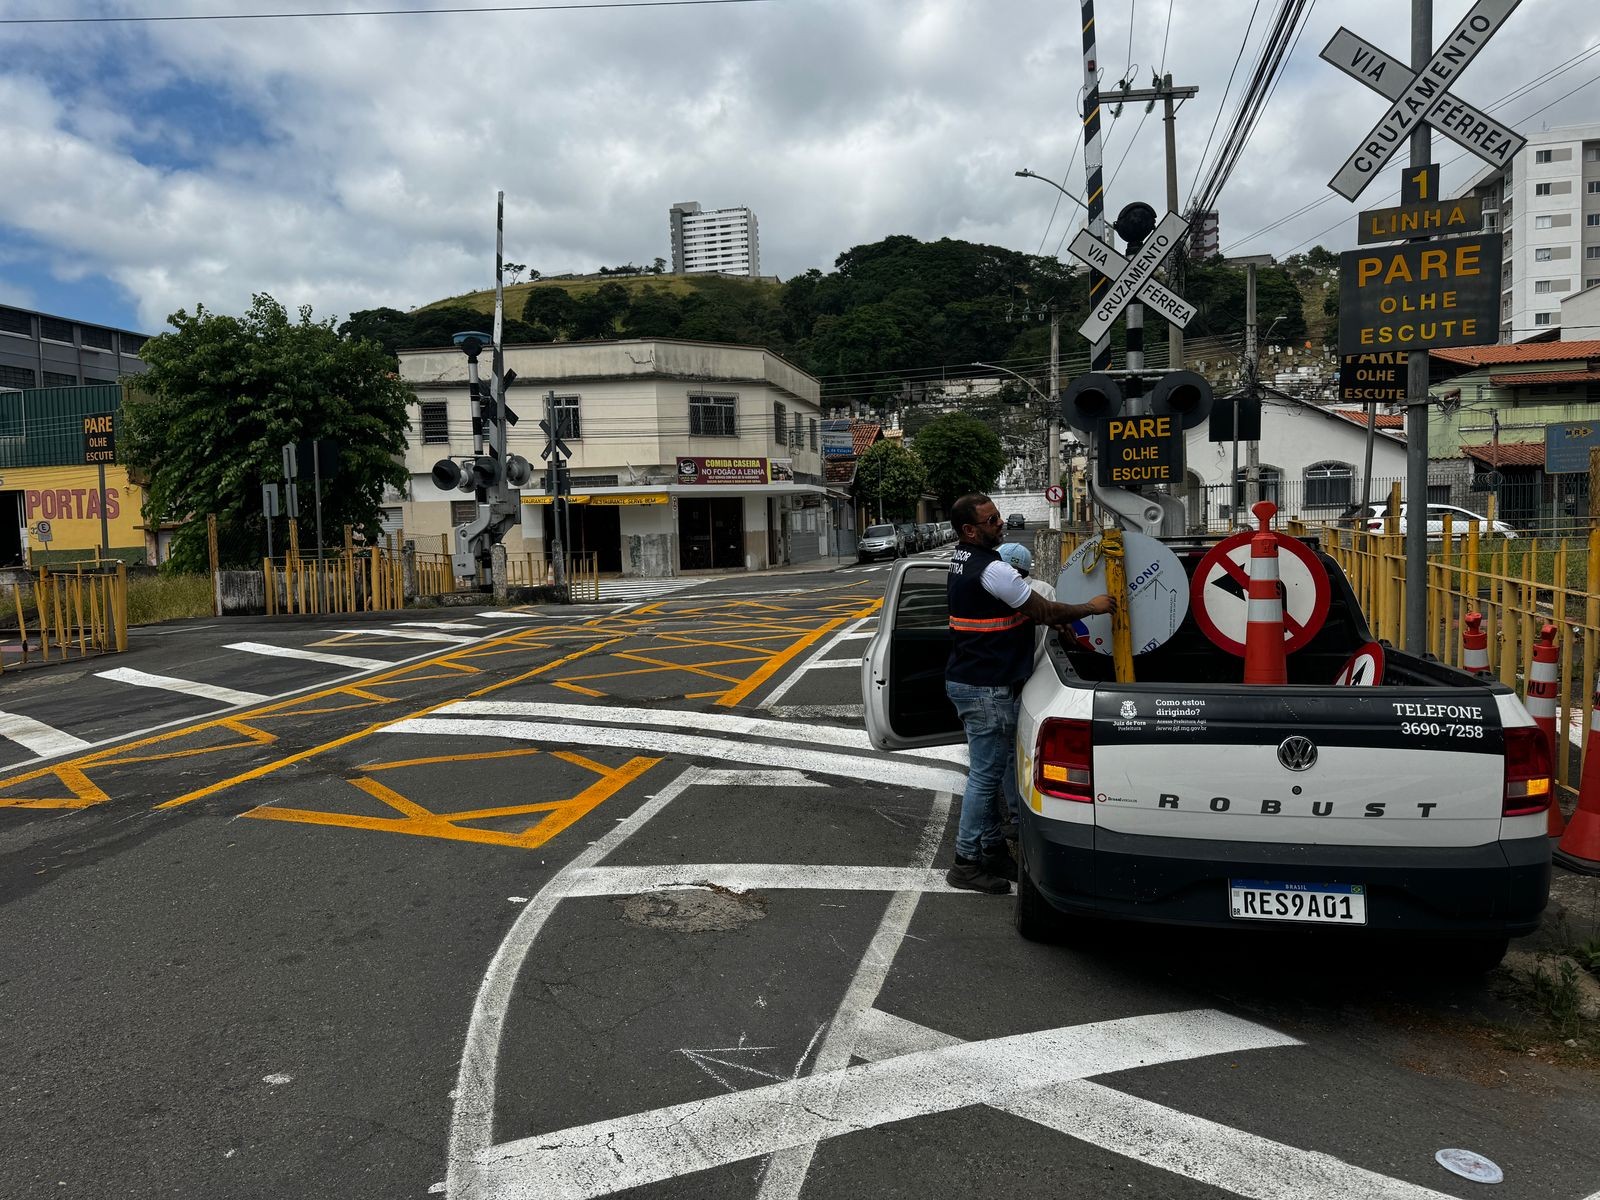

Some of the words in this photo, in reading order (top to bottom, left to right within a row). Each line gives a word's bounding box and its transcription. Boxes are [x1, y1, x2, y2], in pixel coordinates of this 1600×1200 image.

[1351, 47, 1386, 82] VIA
[1354, 15, 1490, 173] CRUZAMENTO
[1430, 100, 1513, 160] FÉRREA
[1412, 170, 1427, 199] 1
[1371, 206, 1466, 236] LINHA
[1087, 244, 1108, 267] VIA
[1358, 244, 1481, 288] PARE
[1097, 234, 1169, 322] CRUZAMENTO
[1142, 284, 1191, 324] FÉRREA
[1379, 291, 1457, 314] OLHE
[1360, 319, 1477, 345] ESCUTE
[1356, 369, 1395, 381] OLHE
[1344, 388, 1405, 399] ESCUTE
[84, 416, 113, 434] PARE
[1109, 417, 1171, 441] PARE
[89, 437, 108, 448] OLHE
[1122, 446, 1159, 461] OLHE
[86, 451, 114, 461] ESCUTE
[705, 459, 733, 468] COMIDA
[733, 459, 761, 468] CASEIRA
[701, 468, 712, 476] NO
[713, 467, 737, 476] FOGÃO
[737, 468, 744, 476] A
[744, 468, 765, 476] LENHA
[1112, 465, 1170, 481] ESCUTE
[26, 488, 120, 520] PORTAS
[1155, 698, 1181, 706] Como
[1182, 698, 1206, 706] estou
[1156, 708, 1200, 717] dirigindo?
[1392, 702, 1483, 720] TELEFONE
[1401, 722, 1484, 739] 3690-7258
[1158, 793, 1437, 818] ROBUST
[1233, 907, 1240, 916] BR
[1243, 891, 1353, 919] RES9A01
